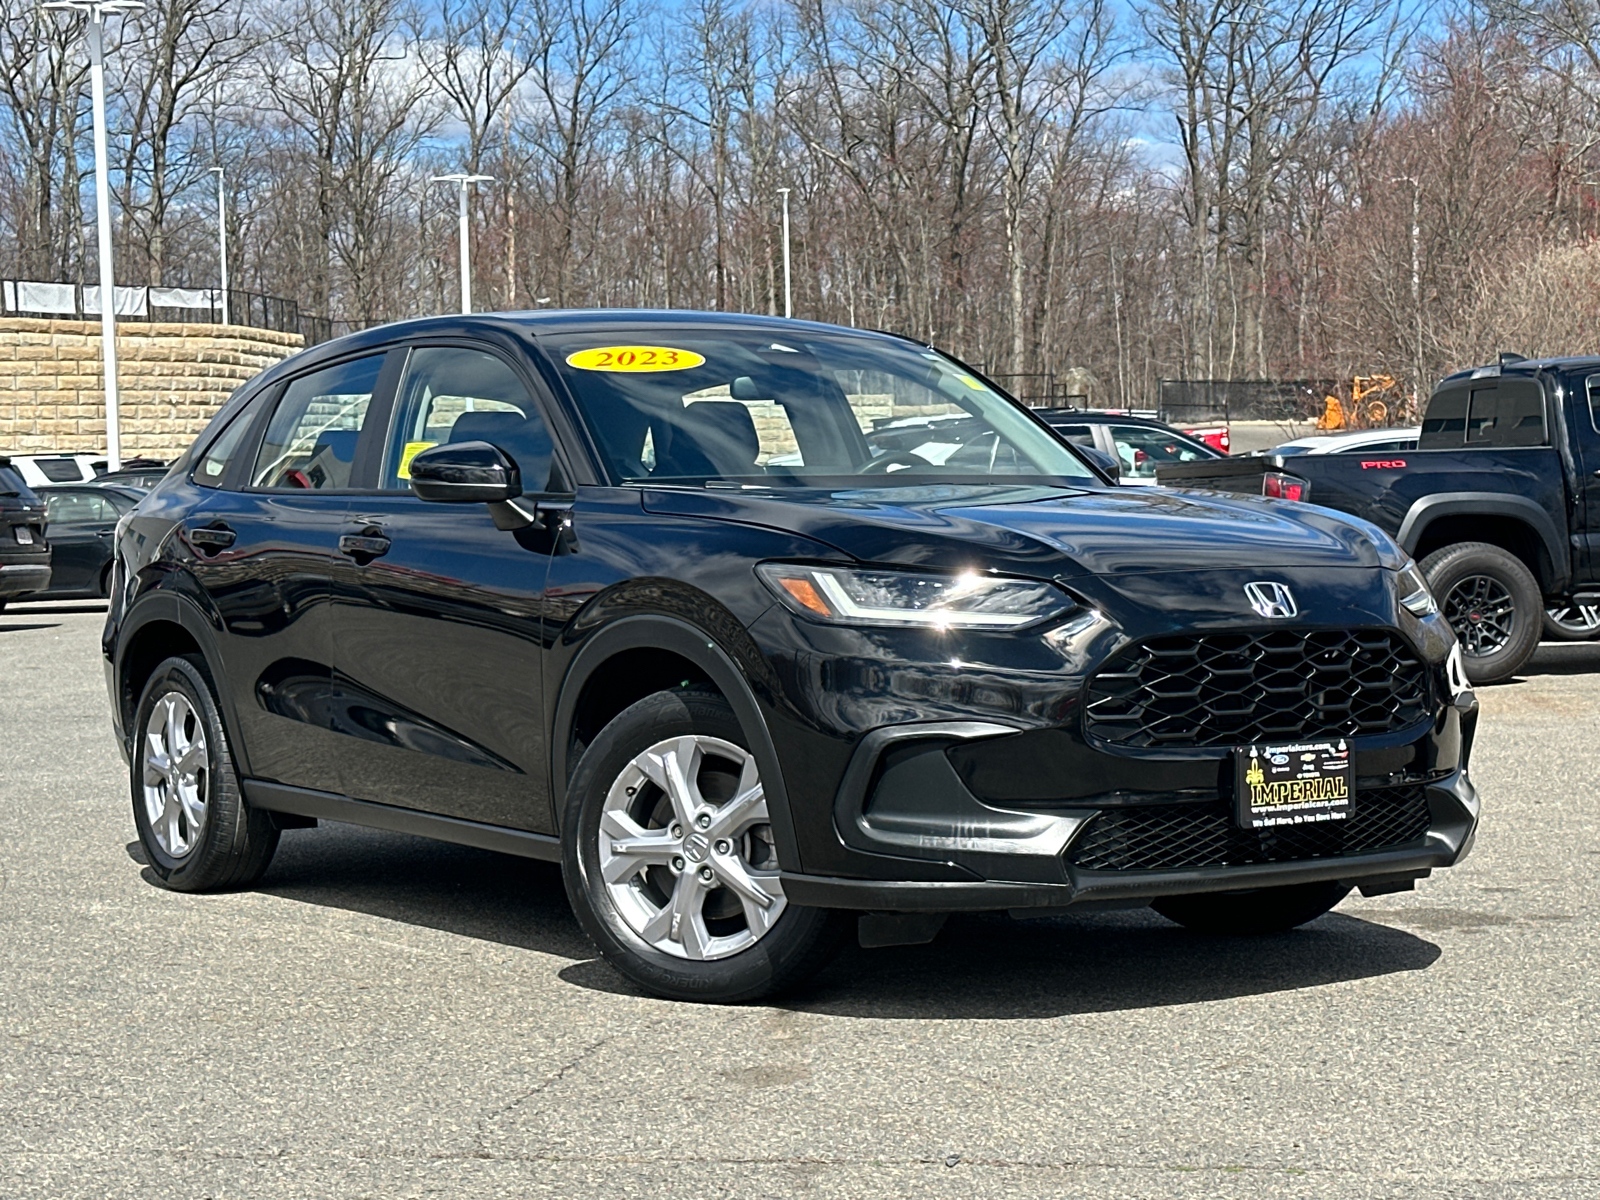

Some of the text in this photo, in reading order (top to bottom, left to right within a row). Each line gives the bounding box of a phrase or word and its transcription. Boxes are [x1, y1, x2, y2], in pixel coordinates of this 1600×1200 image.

[595, 351, 679, 367] 2023
[1361, 459, 1407, 469] PRO
[1251, 776, 1348, 806] IMPERIAL
